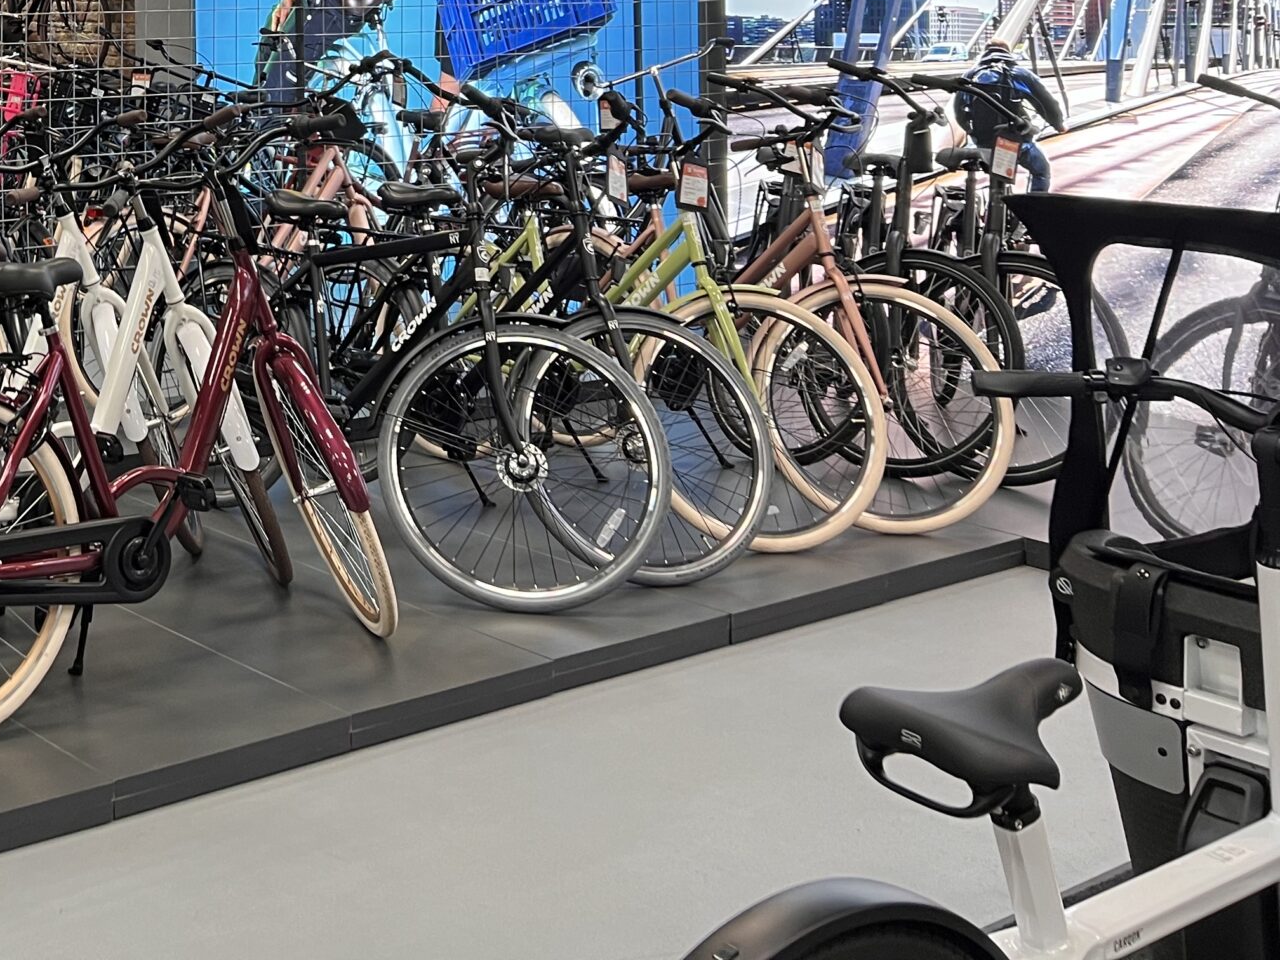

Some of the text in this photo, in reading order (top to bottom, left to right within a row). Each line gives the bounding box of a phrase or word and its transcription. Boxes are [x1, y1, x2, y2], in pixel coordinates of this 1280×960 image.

[131, 287, 155, 355] CROWN
[220, 318, 248, 392] CROWN
[390, 295, 438, 354] CROWN
